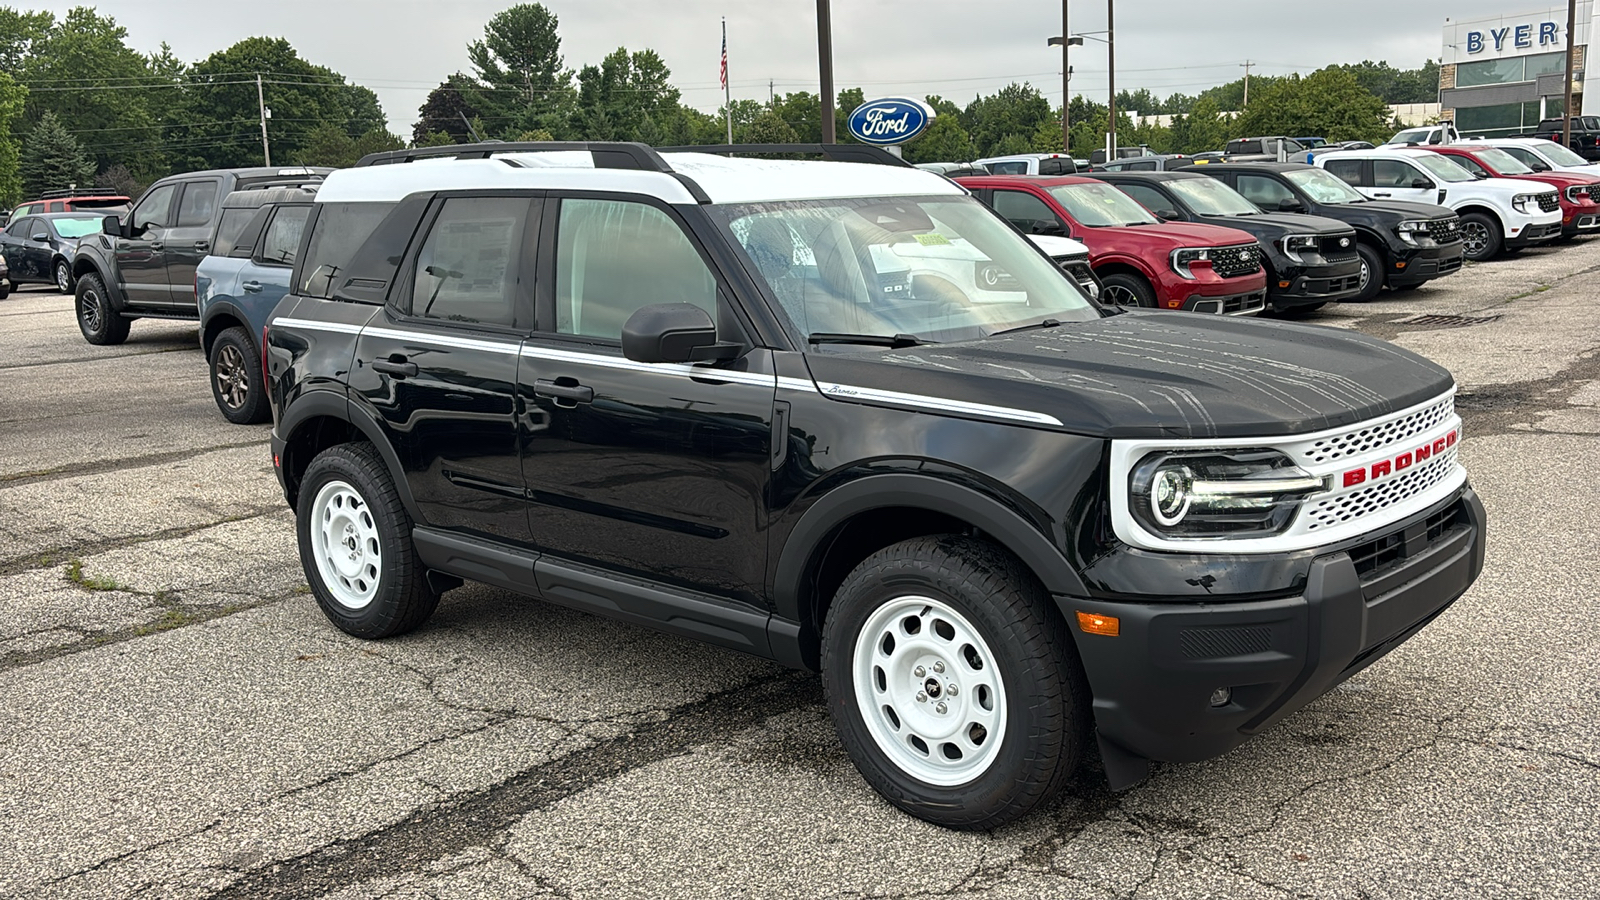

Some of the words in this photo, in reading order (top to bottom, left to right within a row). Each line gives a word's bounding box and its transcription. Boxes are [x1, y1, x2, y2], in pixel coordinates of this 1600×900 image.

[1467, 21, 1569, 54] BYER
[862, 107, 909, 136] Ford
[1343, 430, 1457, 488] BRONCO
